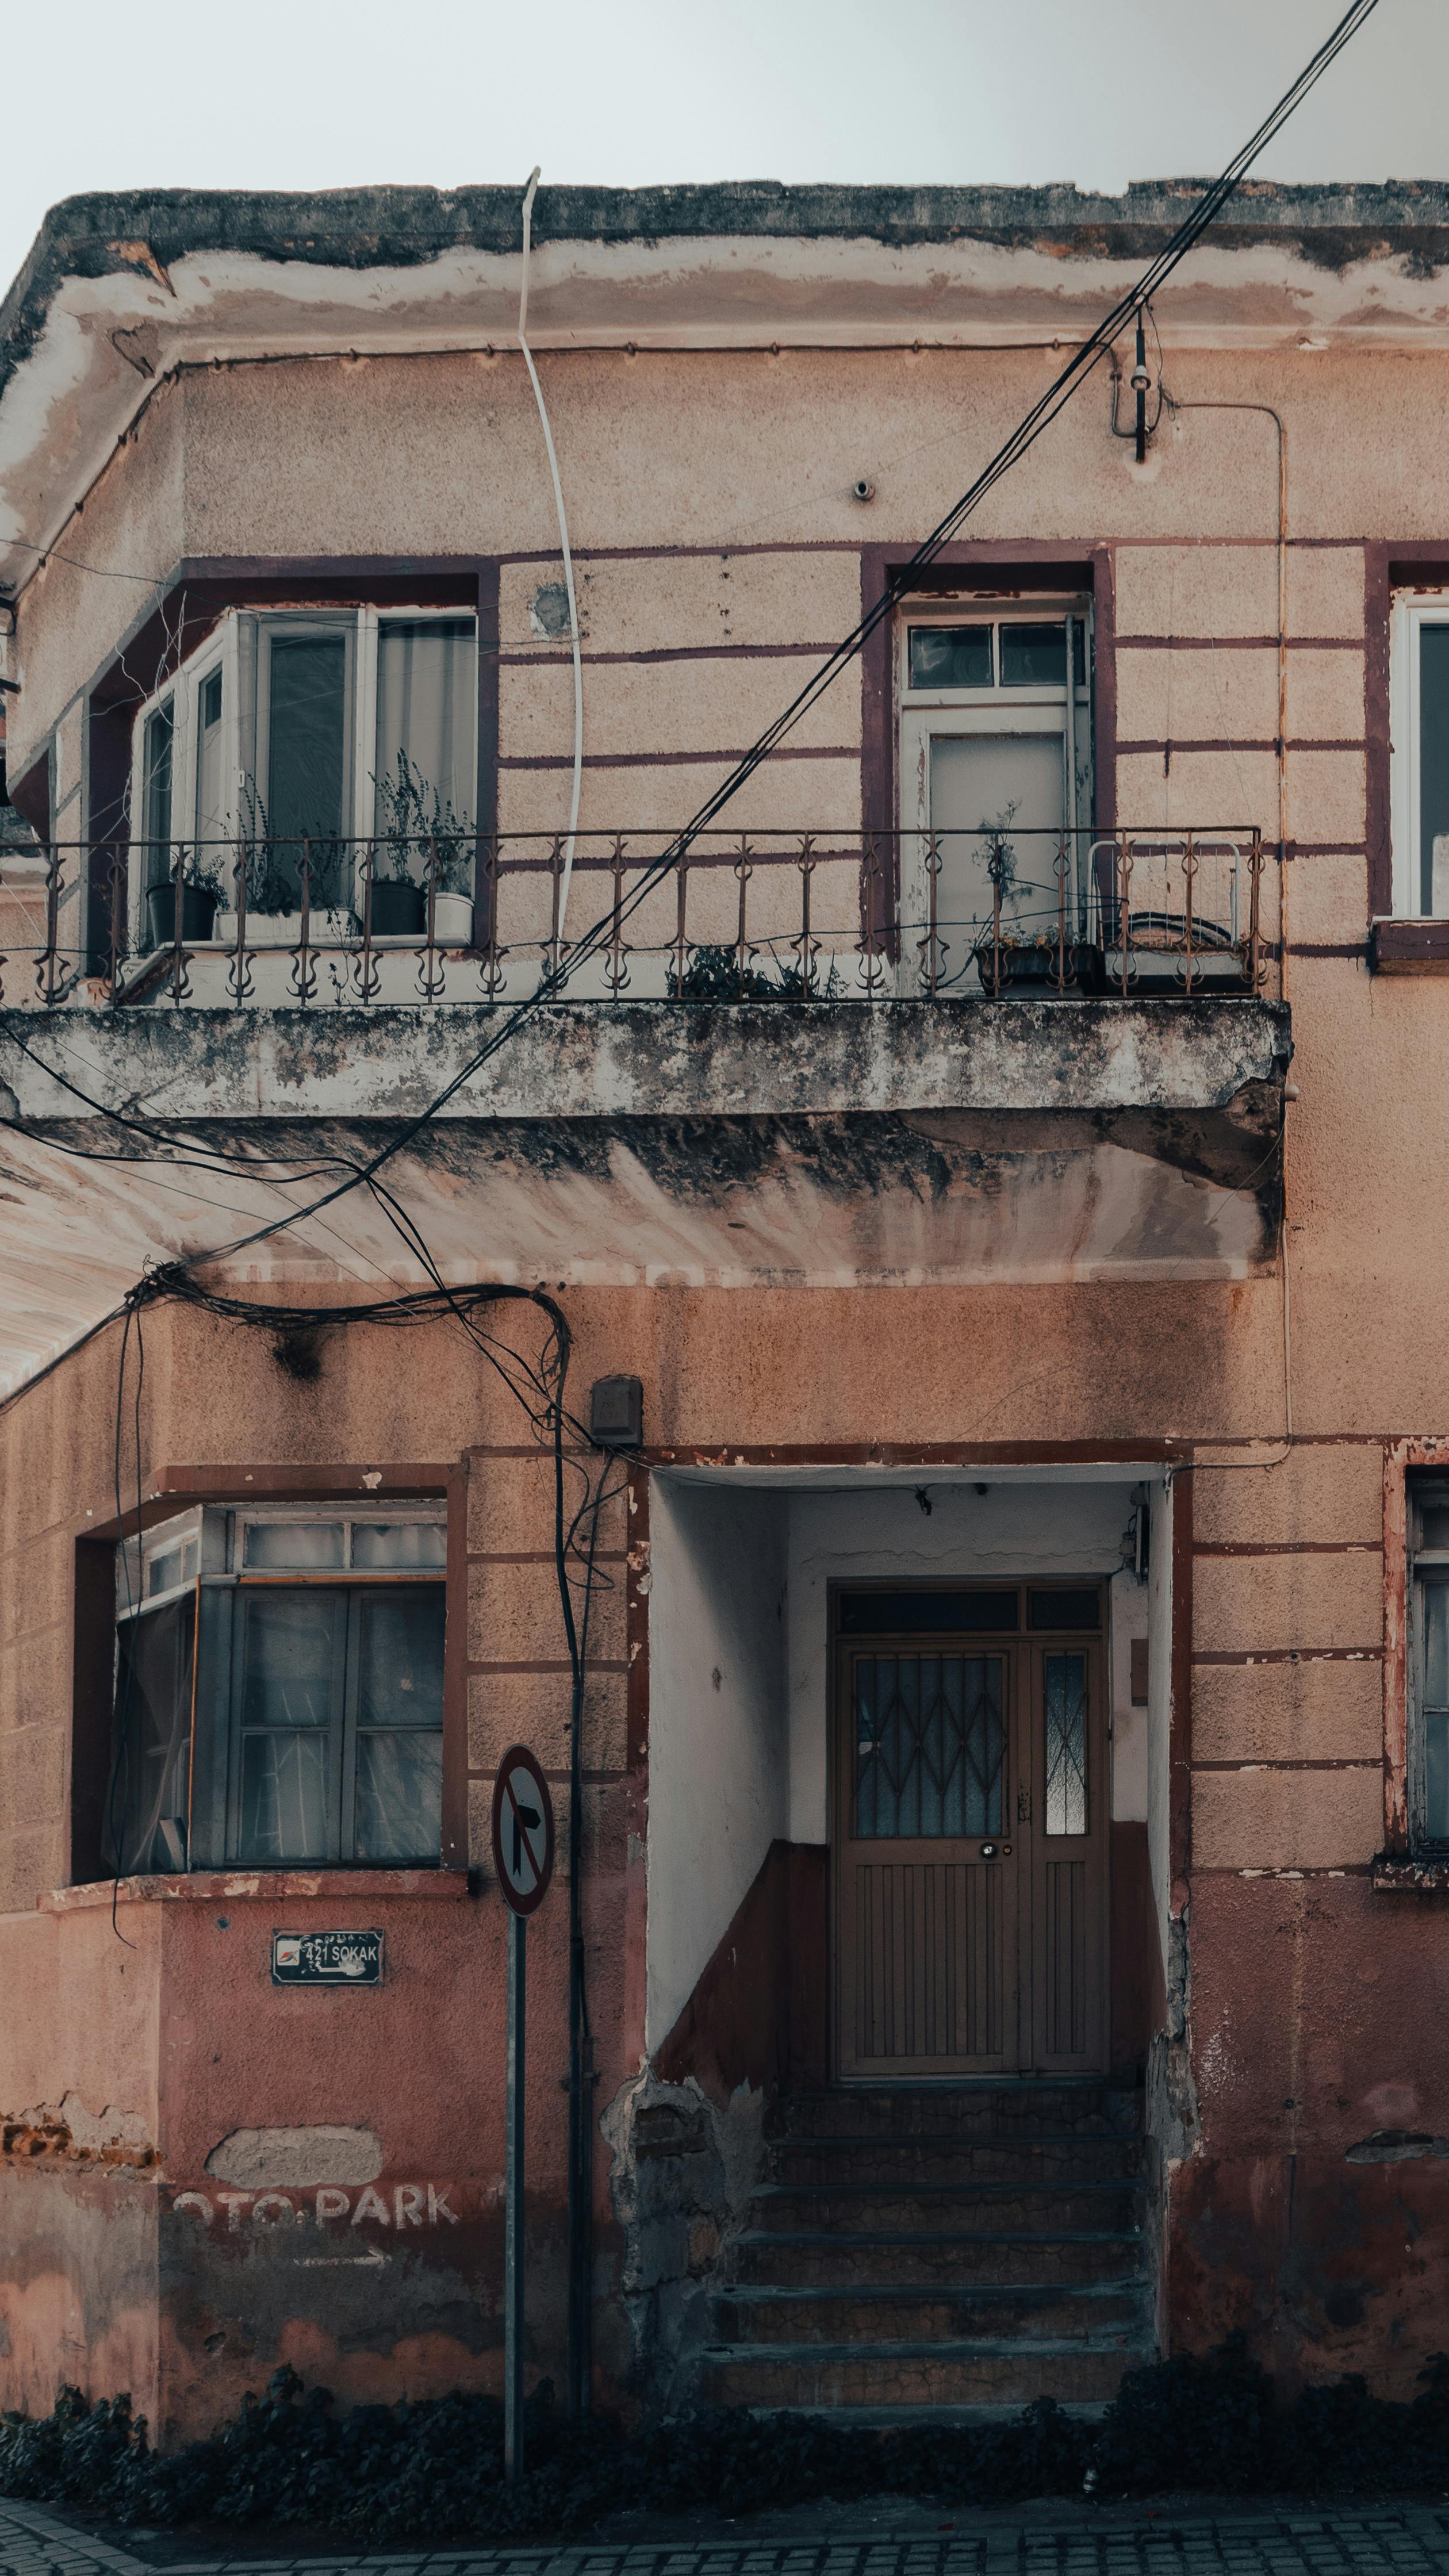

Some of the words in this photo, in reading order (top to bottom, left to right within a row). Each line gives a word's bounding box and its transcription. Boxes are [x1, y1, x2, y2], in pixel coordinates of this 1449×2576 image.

[305, 1946, 328, 1961] 421
[332, 1946, 377, 1961] SOKAK
[316, 2184, 461, 2230] PARK
